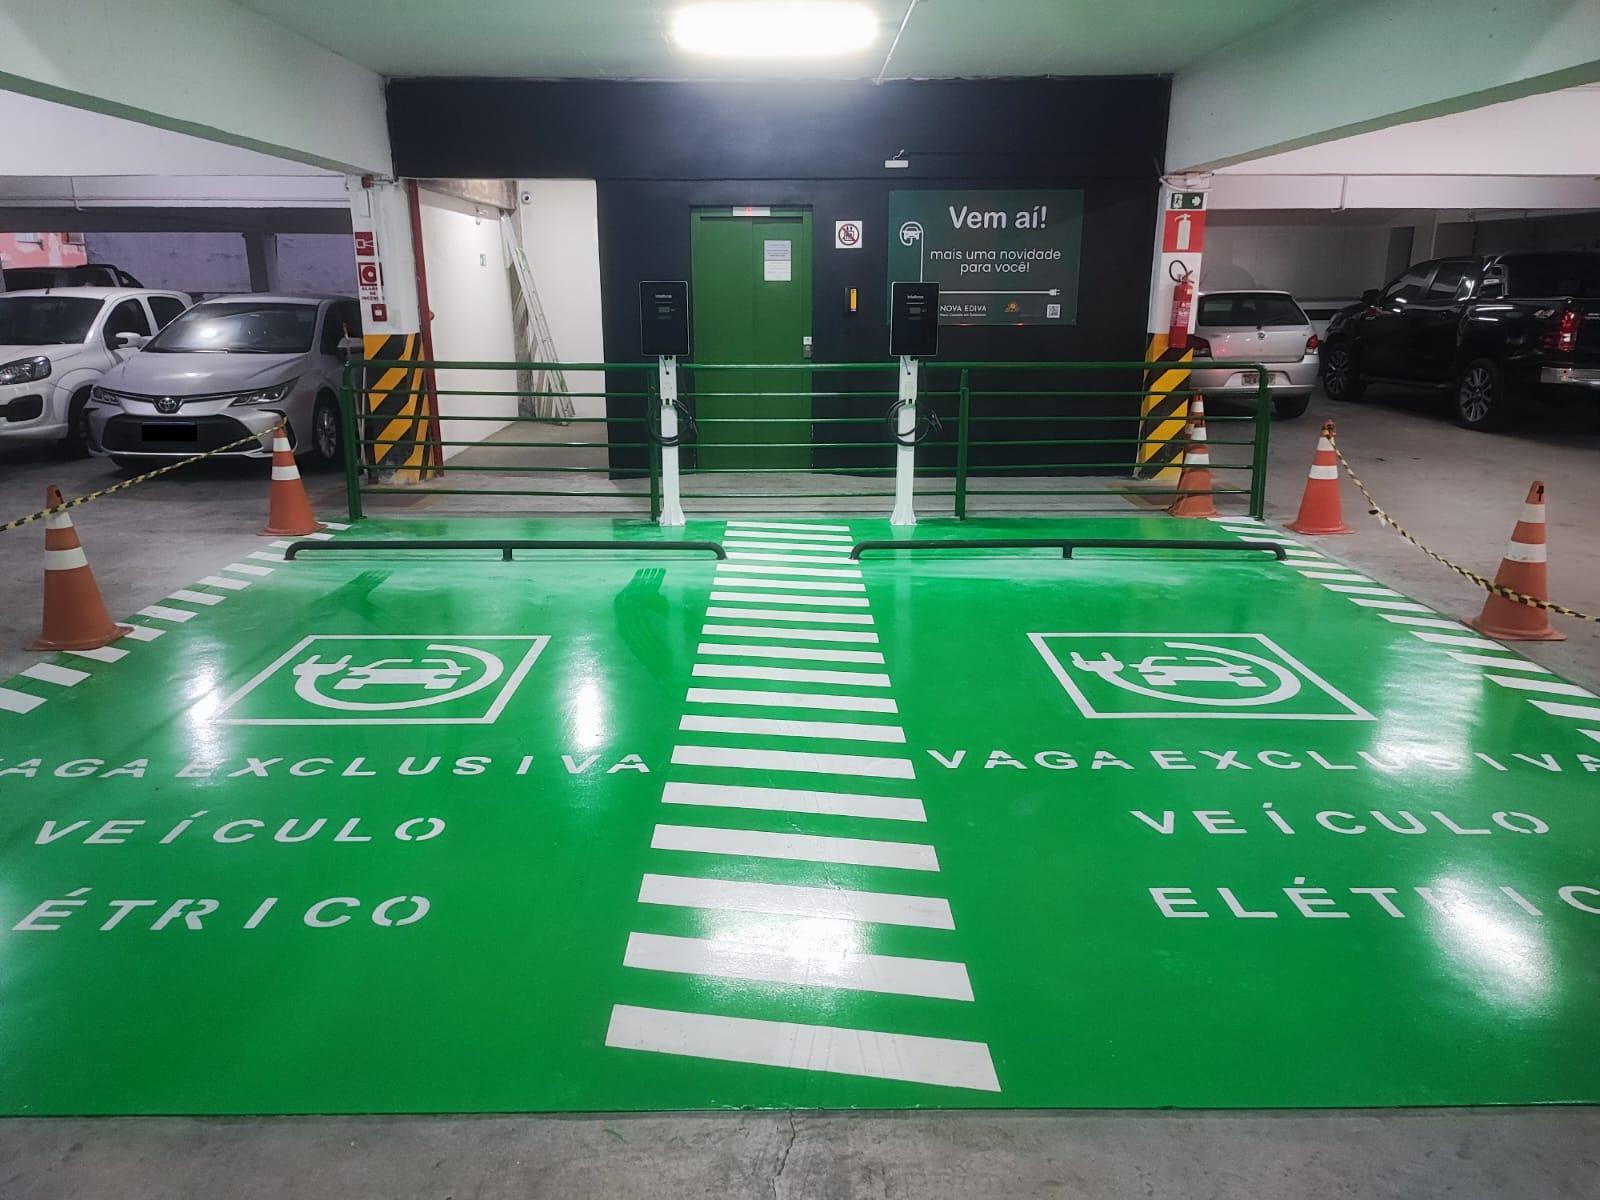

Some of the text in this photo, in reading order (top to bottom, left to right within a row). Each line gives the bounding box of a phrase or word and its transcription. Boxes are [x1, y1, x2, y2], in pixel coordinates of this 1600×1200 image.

[949, 205, 1048, 229] Vem aí!
[929, 247, 1062, 261] mais uma novidade
[960, 261, 1031, 276] para você!
[939, 304, 988, 313] NOVA EDIVA
[0, 754, 652, 779] AGA EXCLUSIVA
[926, 749, 1600, 772] VAGA EXCLUSIVA
[33, 810, 447, 846] VEÍCULO
[1129, 802, 1550, 836] VEÍCULO
[11, 887, 431, 931] ÉTRICO
